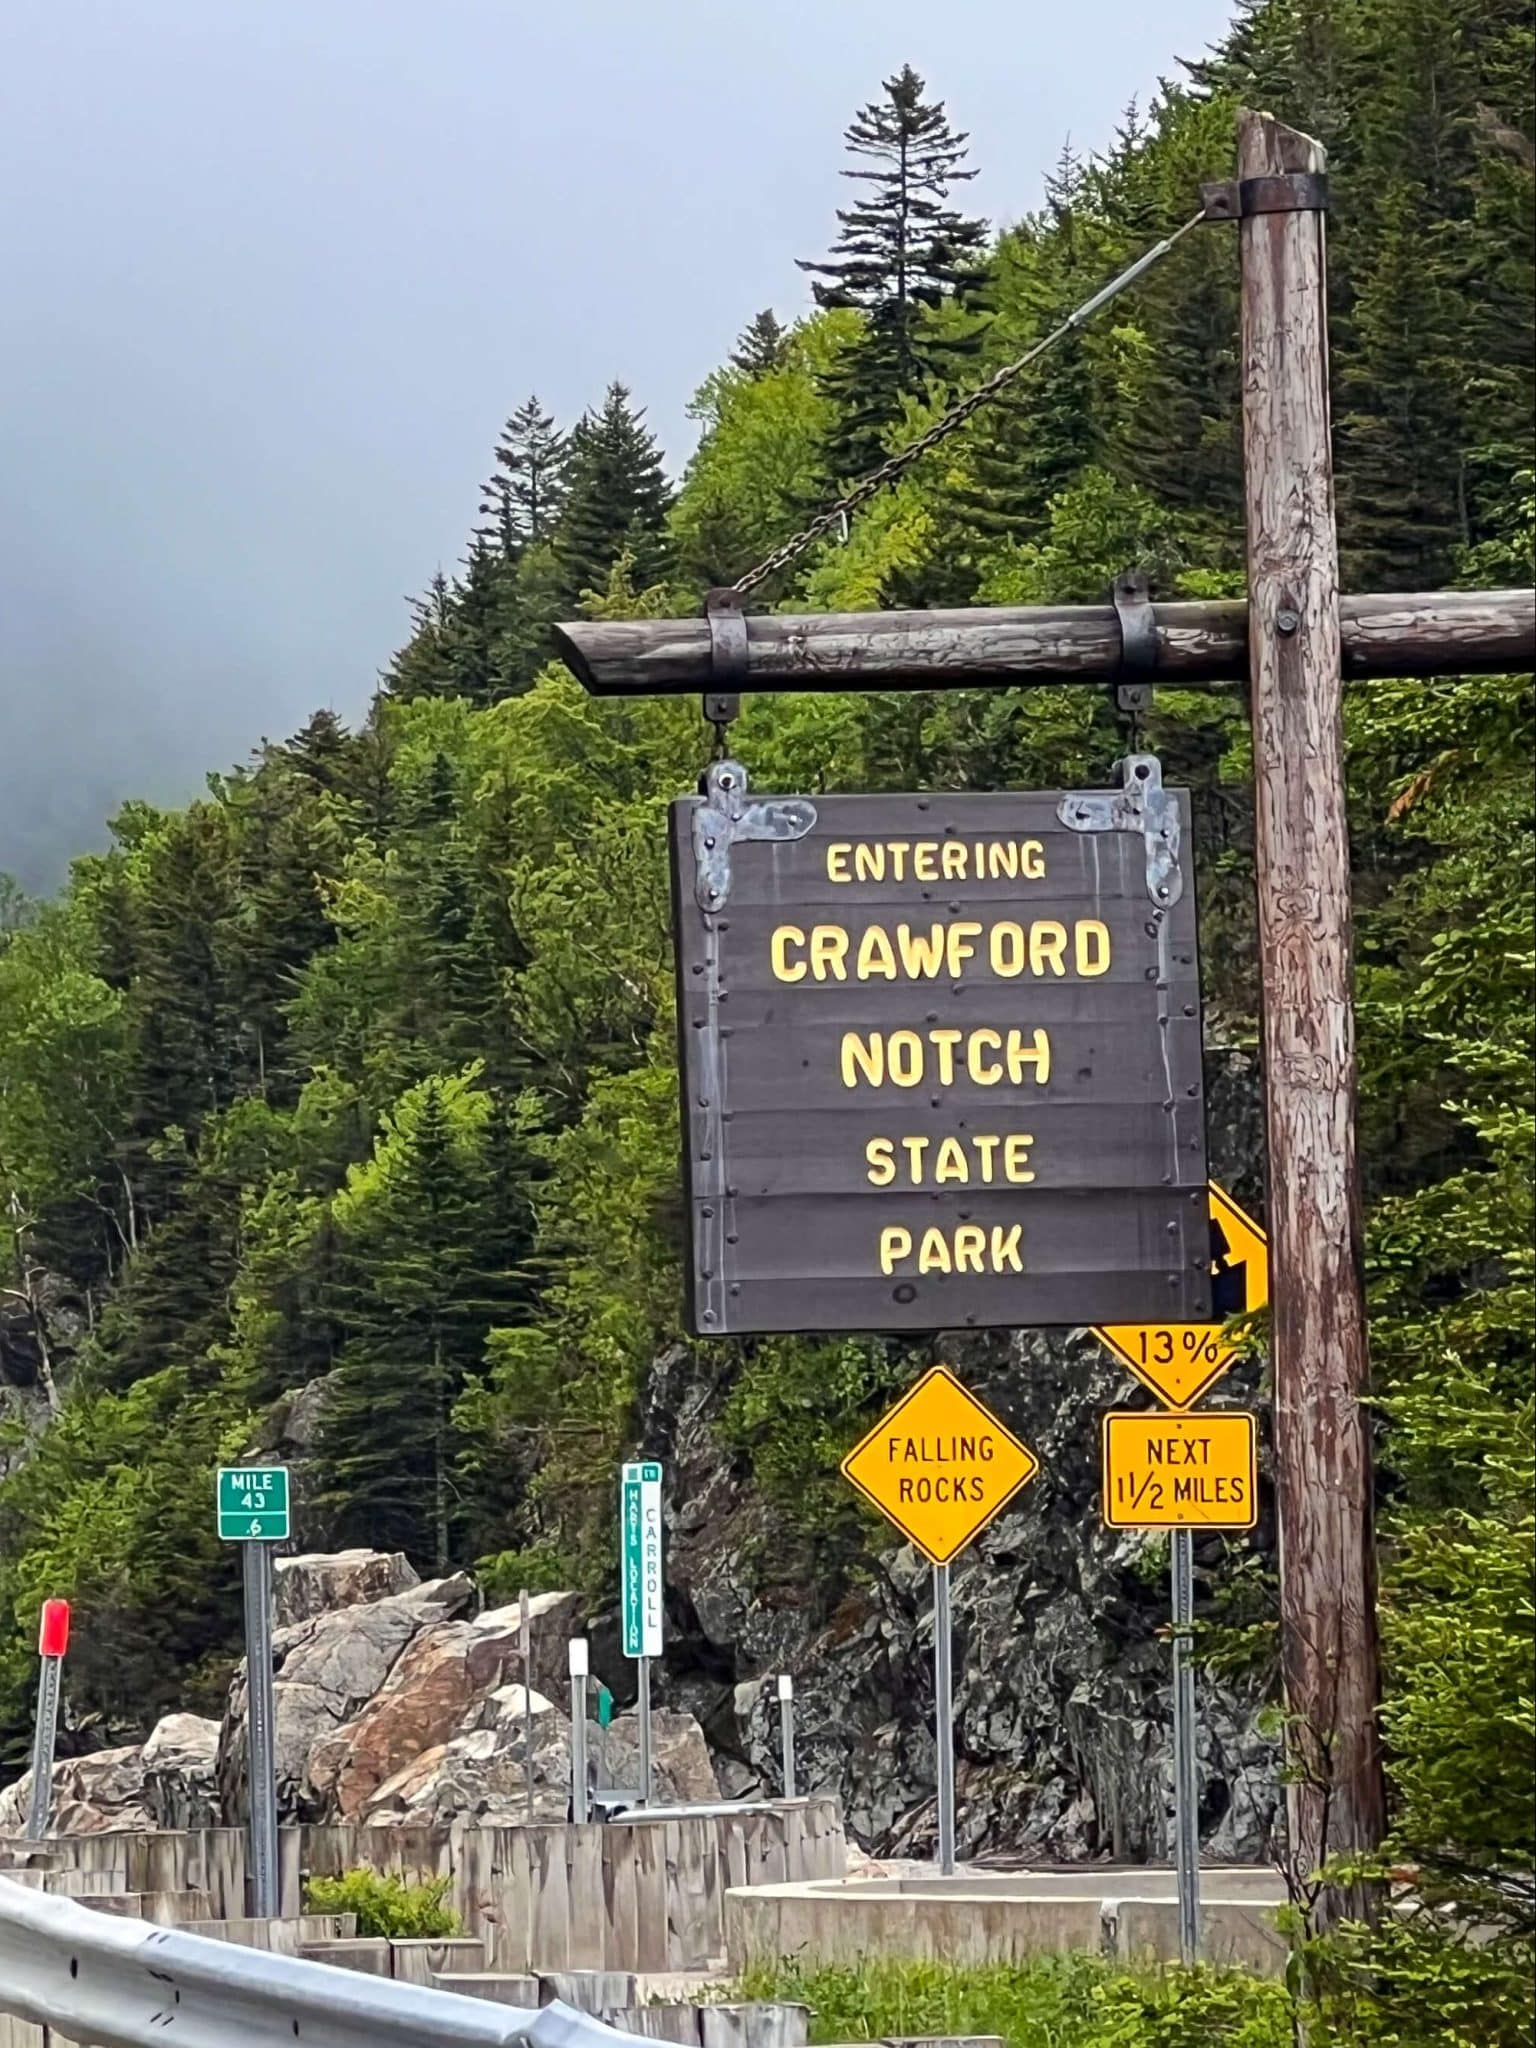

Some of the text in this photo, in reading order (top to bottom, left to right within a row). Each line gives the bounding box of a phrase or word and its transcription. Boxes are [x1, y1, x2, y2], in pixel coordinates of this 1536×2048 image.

[827, 840, 1045, 883] ENTERING
[771, 919, 1112, 983] CRAWFORD
[840, 1028, 1051, 1088] NOTCH
[866, 1134, 1036, 1186] STATE
[879, 1224, 1024, 1275] PARK
[888, 1436, 994, 1463] FALLING
[1147, 1439, 1212, 1465] NEXT
[231, 1474, 273, 1490] MILE
[899, 1477, 985, 1503] ROCKS
[1174, 1477, 1245, 1503] MILES
[241, 1492, 266, 1509] 43
[645, 1508, 657, 1628] CARROLL
